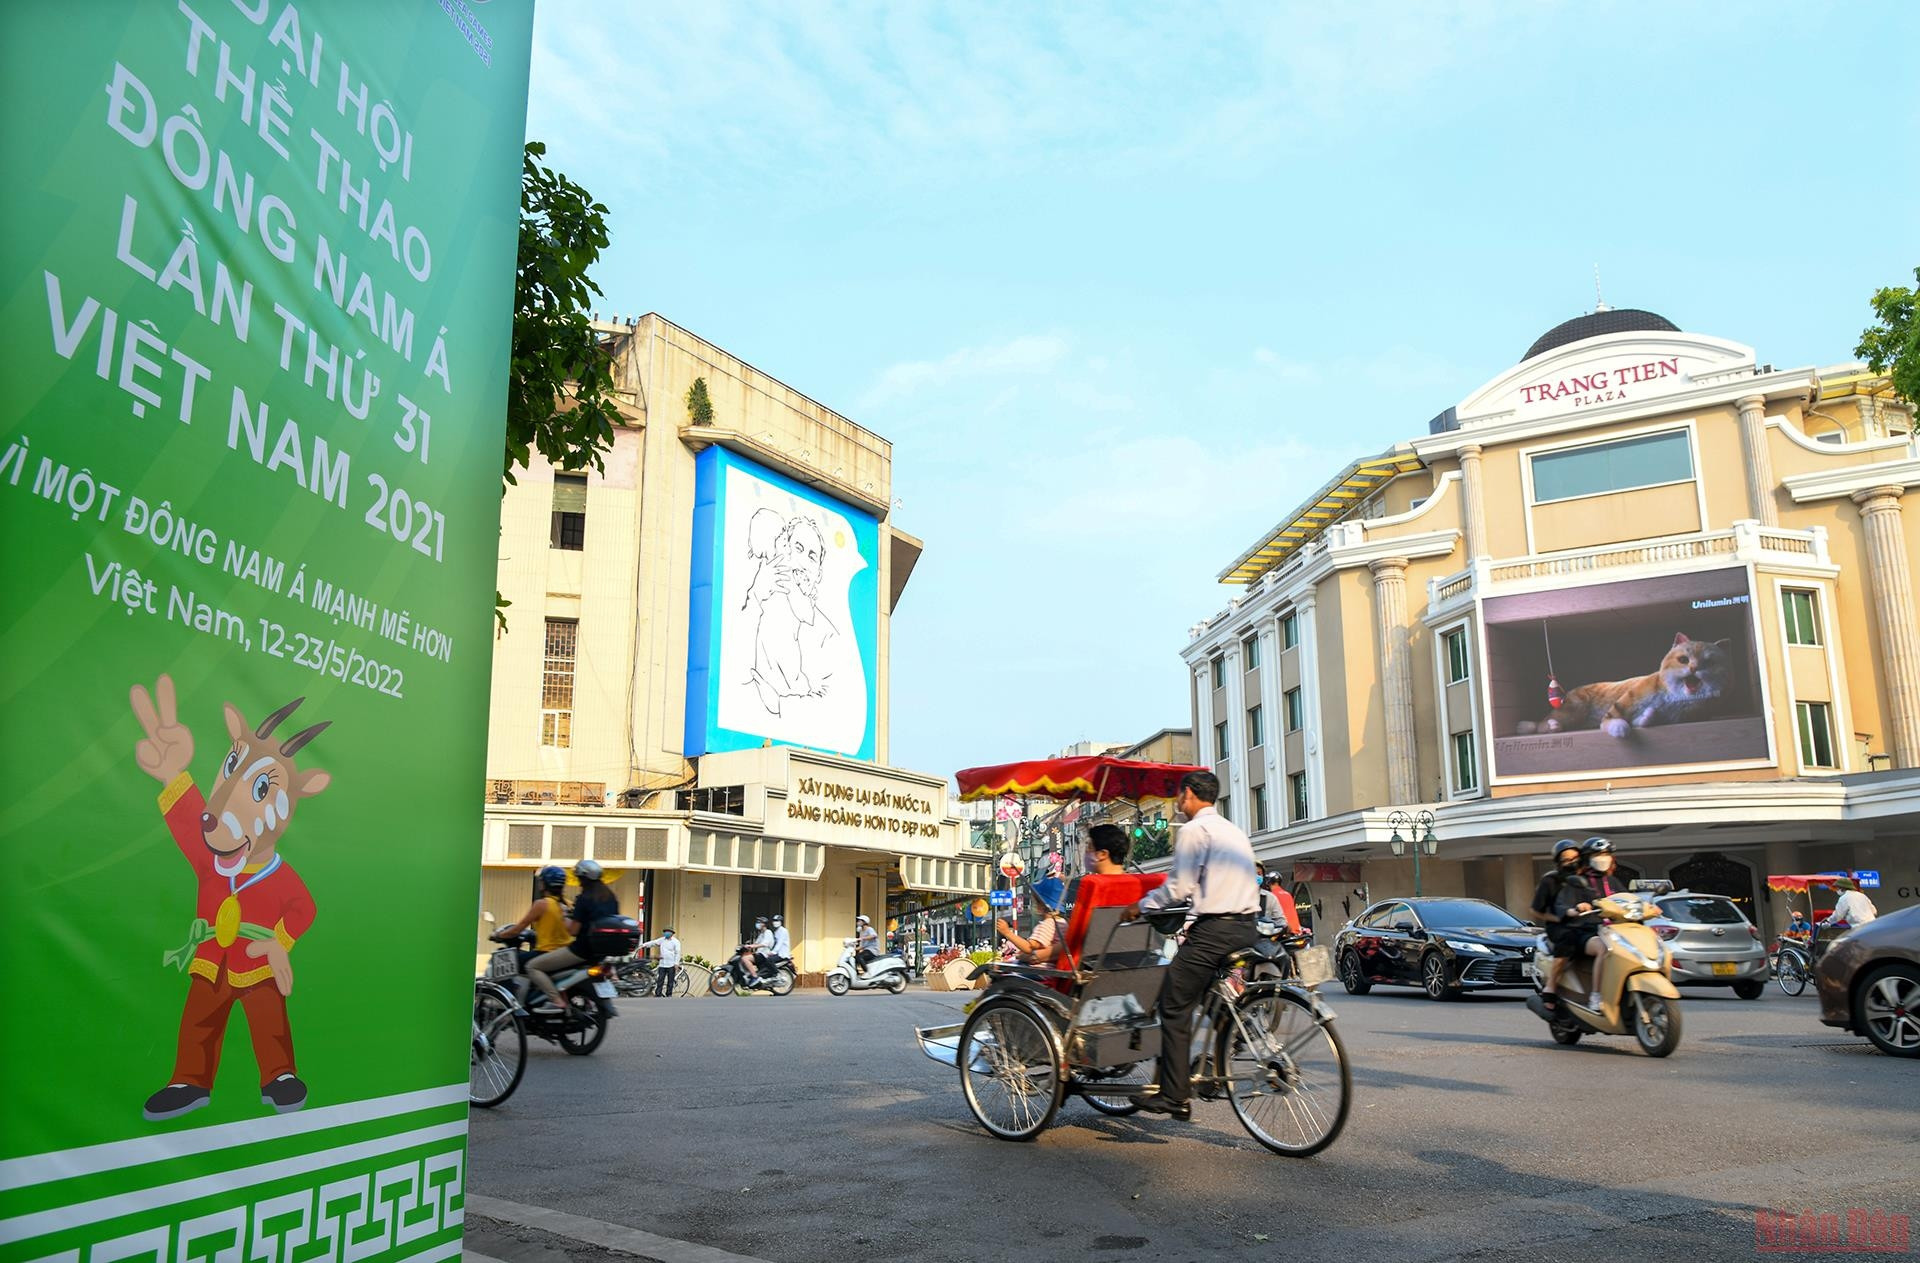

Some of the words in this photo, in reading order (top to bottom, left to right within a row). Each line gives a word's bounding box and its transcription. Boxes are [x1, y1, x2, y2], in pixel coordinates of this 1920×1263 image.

[466, 10, 494, 50] GAMES
[474, 37, 493, 69] 2021
[178, 0, 294, 162] THỂ
[310, 127, 432, 283] THAO
[337, 61, 413, 183] HỘI
[105, 62, 297, 263] ĐÔNG
[313, 234, 415, 362] NAM
[423, 325, 452, 394] Á
[116, 194, 254, 343] LẦN
[274, 302, 381, 420] THỨ
[393, 393, 431, 465] 31
[45, 271, 212, 425] VIỆT
[227, 385, 351, 510] NAM
[364, 473, 445, 563] 2021
[1520, 371, 1608, 404] TRANG
[1613, 357, 1679, 387] TIEN
[1575, 390, 1626, 406] PLAZA
[32, 456, 121, 522] MỘT
[123, 495, 218, 565] ĐÔNG
[223, 539, 285, 593] NAM
[287, 563, 305, 604] Á
[311, 578, 377, 632] MẠNH
[379, 606, 411, 647] MẼ
[412, 623, 453, 664] HƠN
[85, 552, 158, 616] Việt
[167, 585, 251, 653] Nam,
[259, 618, 403, 699] 12-23/5/2022
[1692, 597, 1732, 609] Unilumin
[856, 788, 871, 807] LẠI
[921, 800, 932, 815] TA
[864, 814, 887, 832] HƠN
[887, 818, 900, 833] TO
[901, 820, 919, 838] ĐẸP
[919, 821, 940, 839] HƠN
